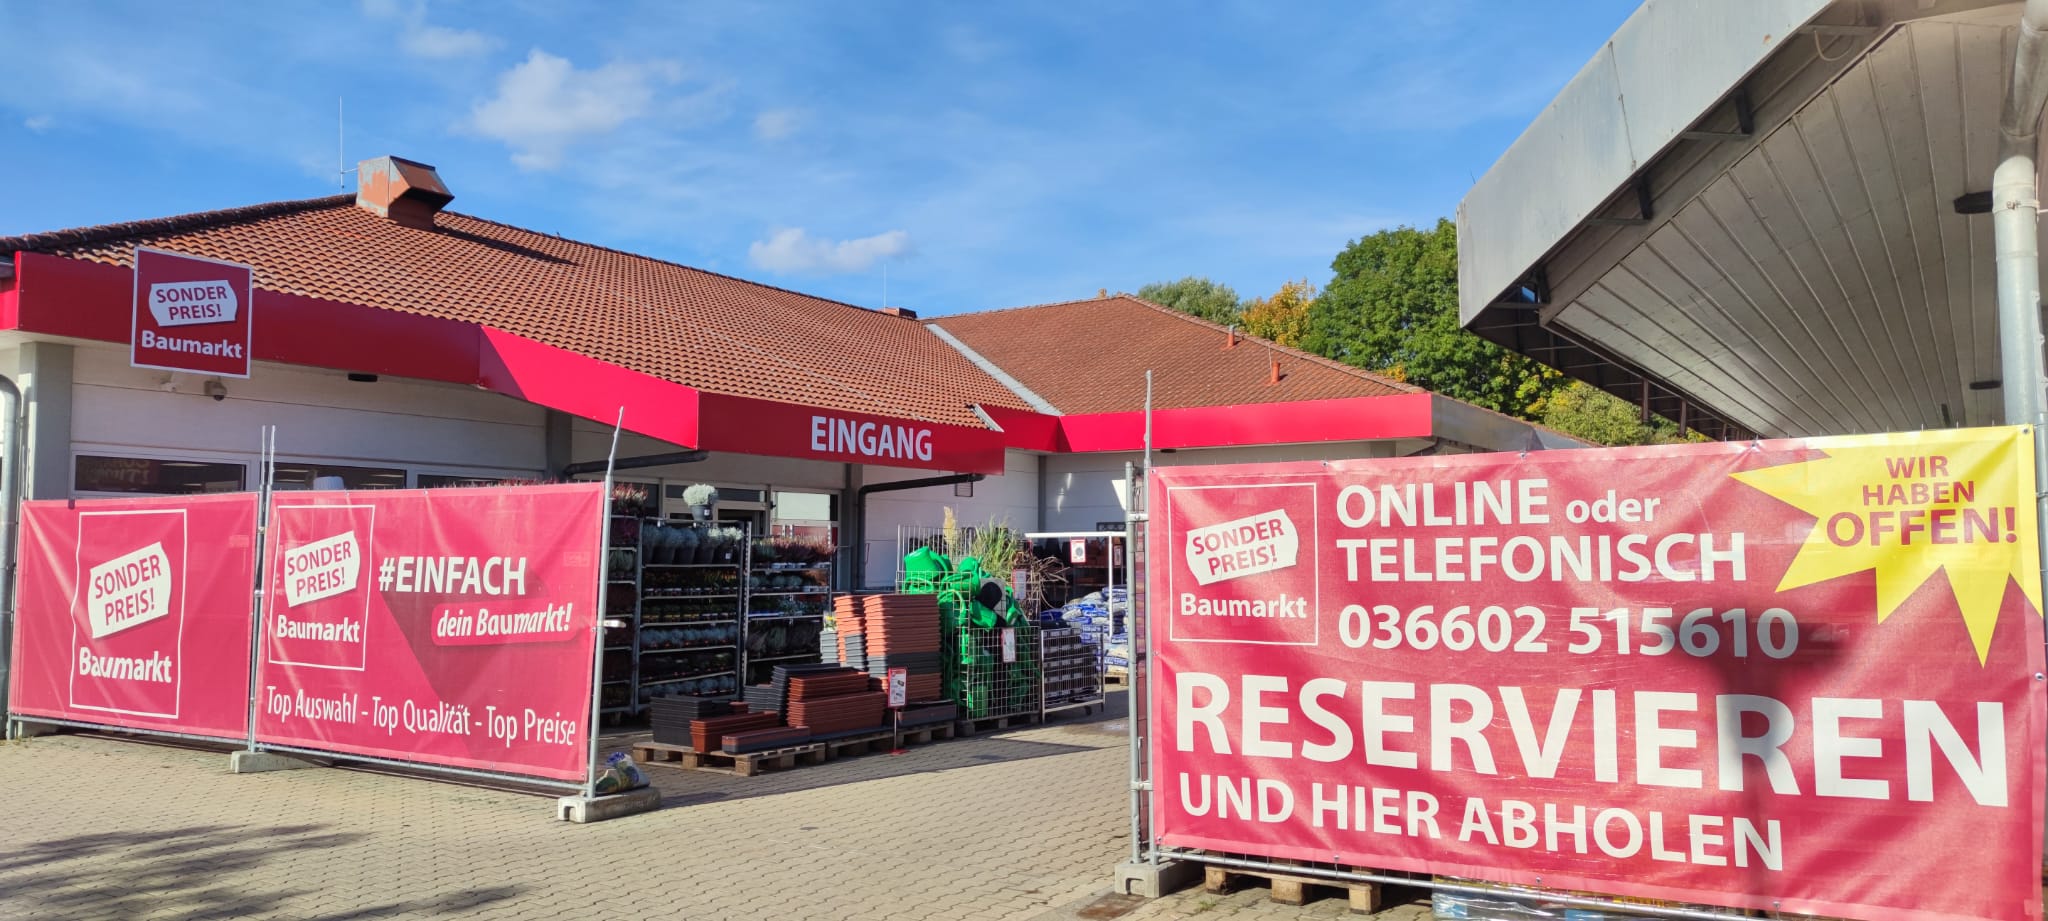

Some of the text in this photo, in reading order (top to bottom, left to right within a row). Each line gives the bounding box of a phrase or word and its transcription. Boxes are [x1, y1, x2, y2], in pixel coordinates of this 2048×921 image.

[155, 285, 228, 303] SONDER
[168, 303, 222, 321] PREIS!
[141, 330, 243, 359] Baumarkt
[811, 415, 933, 461] EINGANG
[1886, 455, 1949, 479] WIR
[1336, 479, 1661, 528] ONLINE oder
[1862, 481, 1975, 506] HABEN
[1192, 518, 1284, 556] SONDER
[1827, 507, 2018, 547] OFFEN!
[287, 541, 352, 577] SONDER
[378, 556, 526, 595] #EINFACH
[1208, 544, 1278, 575] PREIS!
[1337, 532, 1746, 582] TELEFONISCH
[94, 555, 161, 599] SONDER
[295, 563, 346, 598] PREIS!
[105, 590, 155, 626] PREIS!
[436, 602, 574, 639] dein Baumarkt!
[1180, 593, 1307, 619] Baumarkt
[277, 614, 360, 644] Baumarkt
[1338, 605, 1799, 659] 036602 515610
[79, 646, 172, 684] Baumarkt
[266, 686, 292, 723] Top
[295, 688, 357, 726] Auswahl
[371, 696, 399, 735] Top
[403, 699, 471, 736] Qualität
[486, 705, 518, 747] Top
[524, 710, 576, 747] Preise
[1175, 672, 2009, 807] RESERVIEREN
[1179, 772, 1783, 871] UND HIER ABHOLEN
